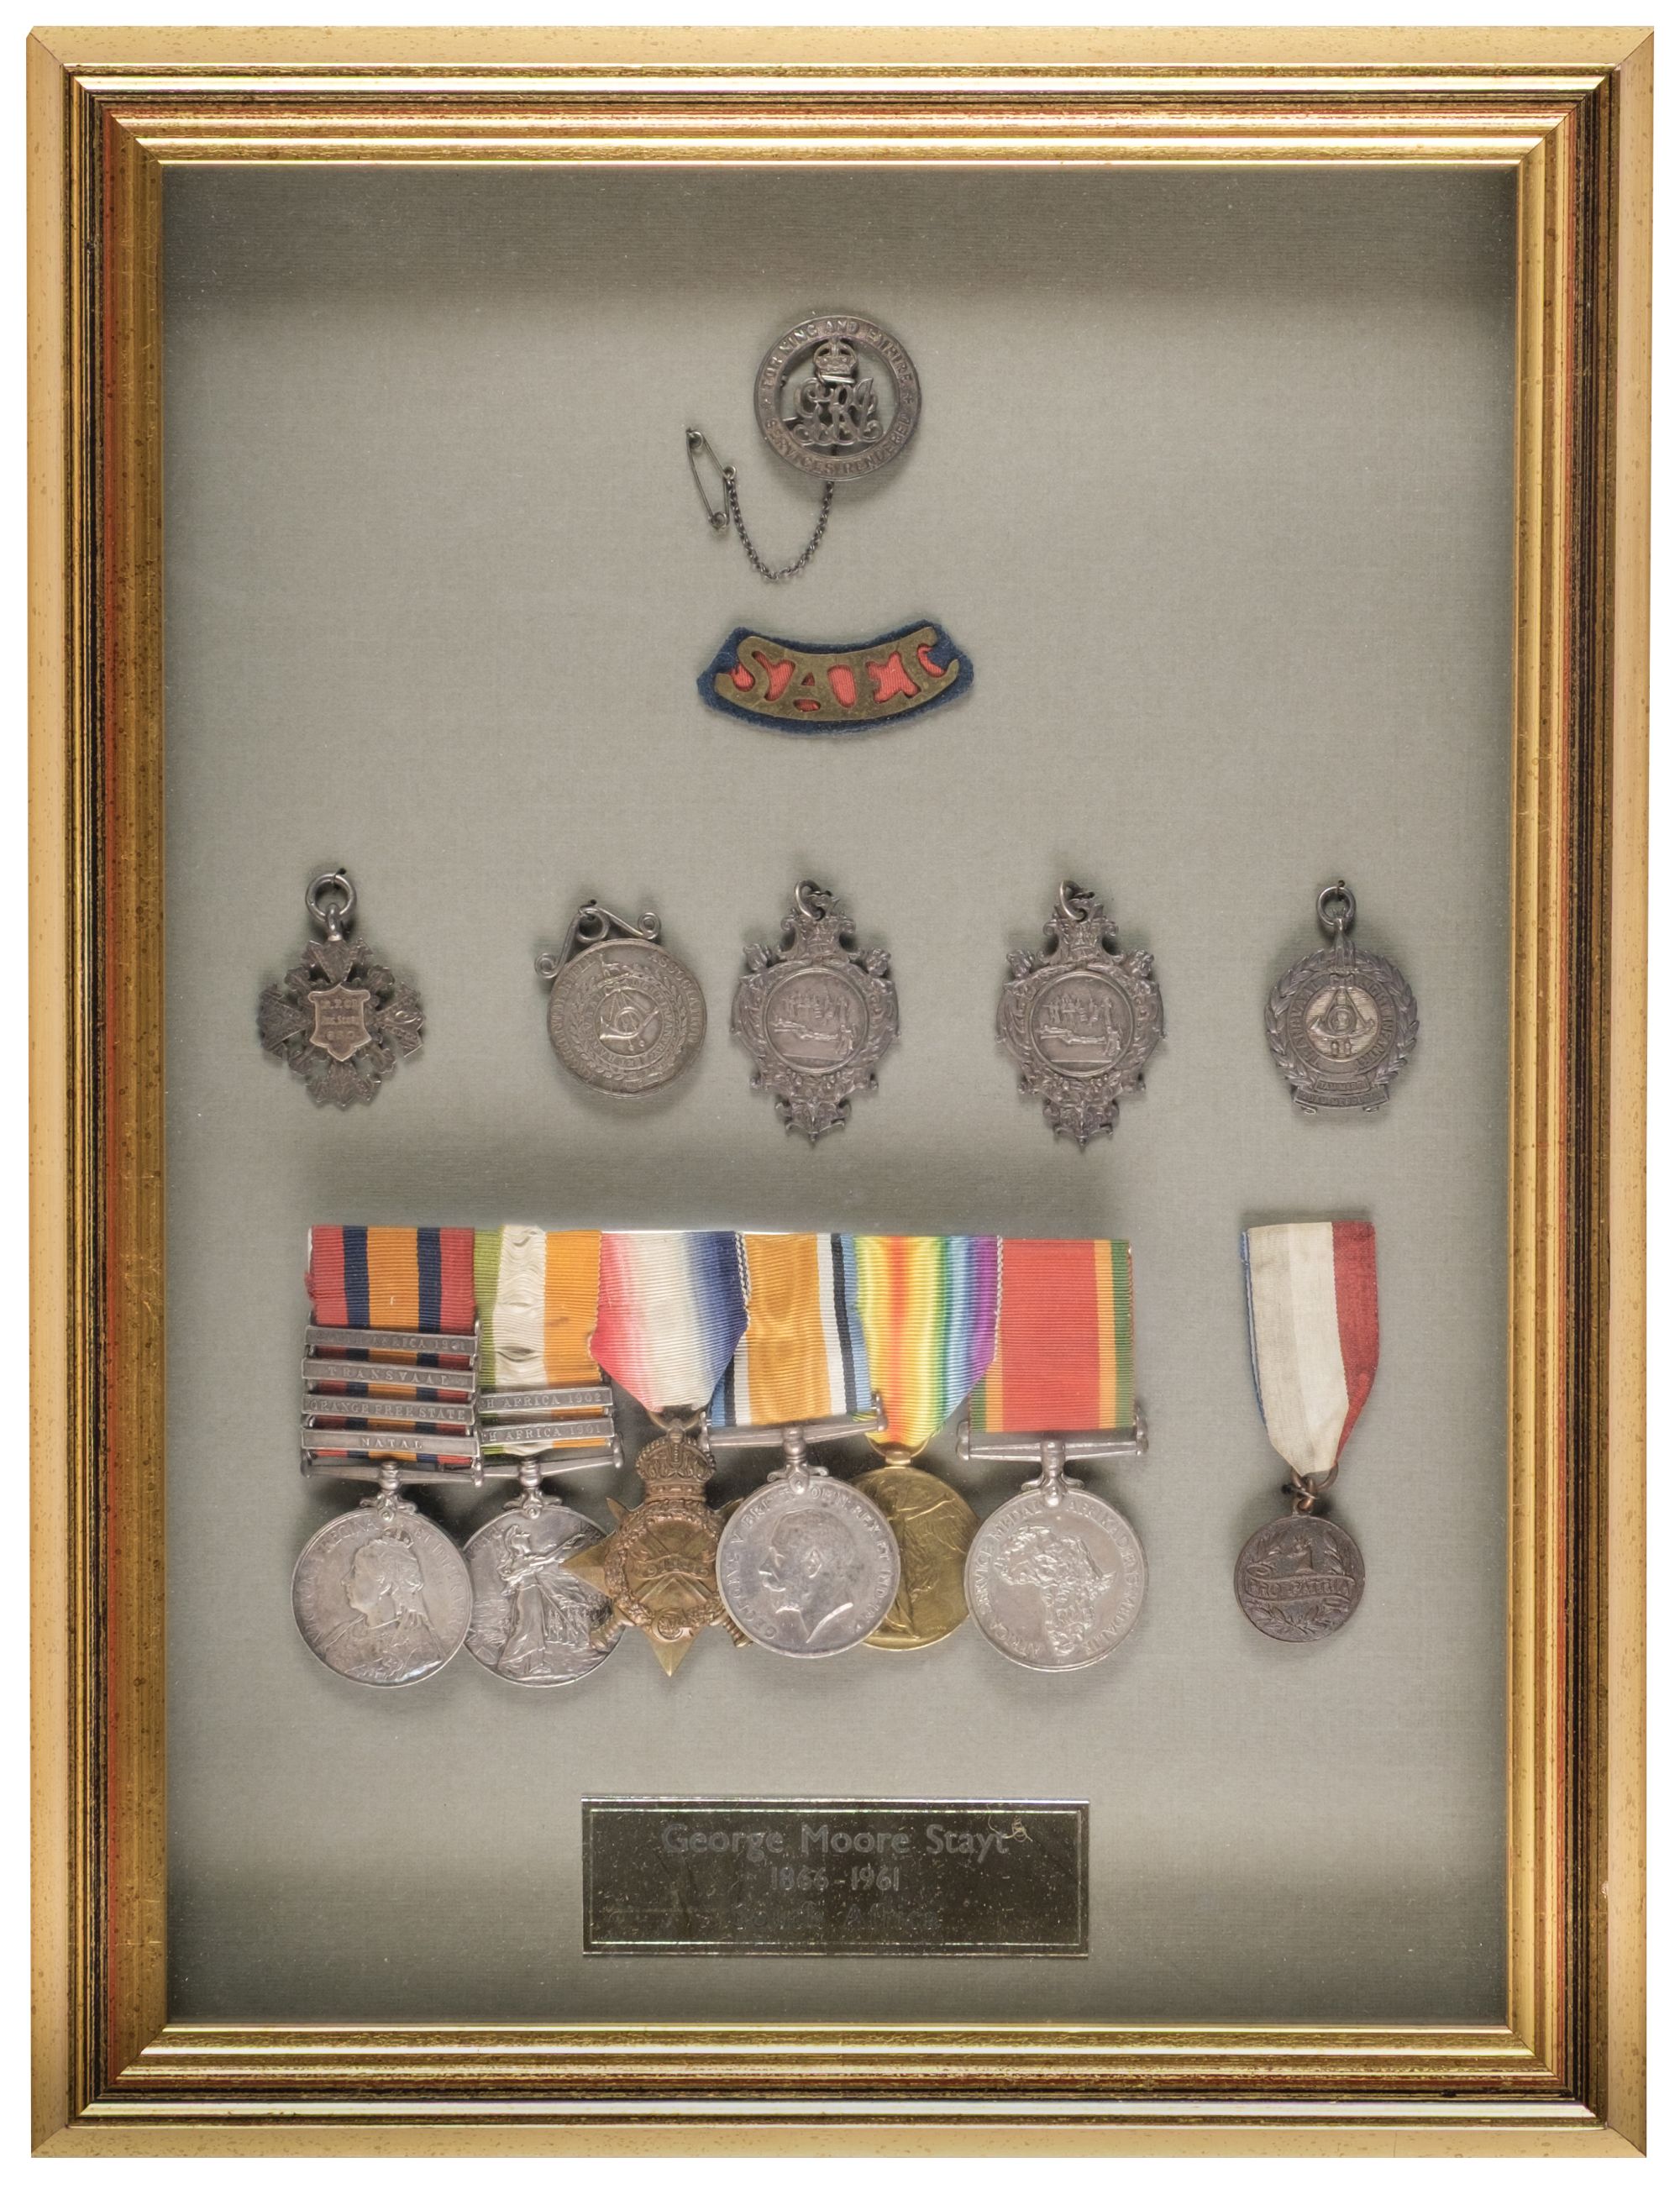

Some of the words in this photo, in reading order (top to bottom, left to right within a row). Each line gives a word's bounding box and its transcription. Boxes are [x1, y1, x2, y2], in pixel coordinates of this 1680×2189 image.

[780, 325, 819, 355] KING
[824, 319, 860, 334] AND
[842, 414, 913, 475] RENDERED
[327, 1366, 449, 1386] TRANSVAAL
[309, 1399, 375, 1415] ORANGE
[375, 1404, 416, 1418] FREE
[418, 1407, 465, 1421] STATE
[503, 1394, 560, 1408] AFRICA
[568, 1392, 602, 1404] 1902
[505, 1427, 562, 1441] AFRICA
[570, 1424, 601, 1436] 1901
[360, 1437, 423, 1450] NATAL
[659, 1822, 783, 1862] George
[801, 1824, 911, 1854] Moore
[926, 1825, 1009, 1863] Stayt
